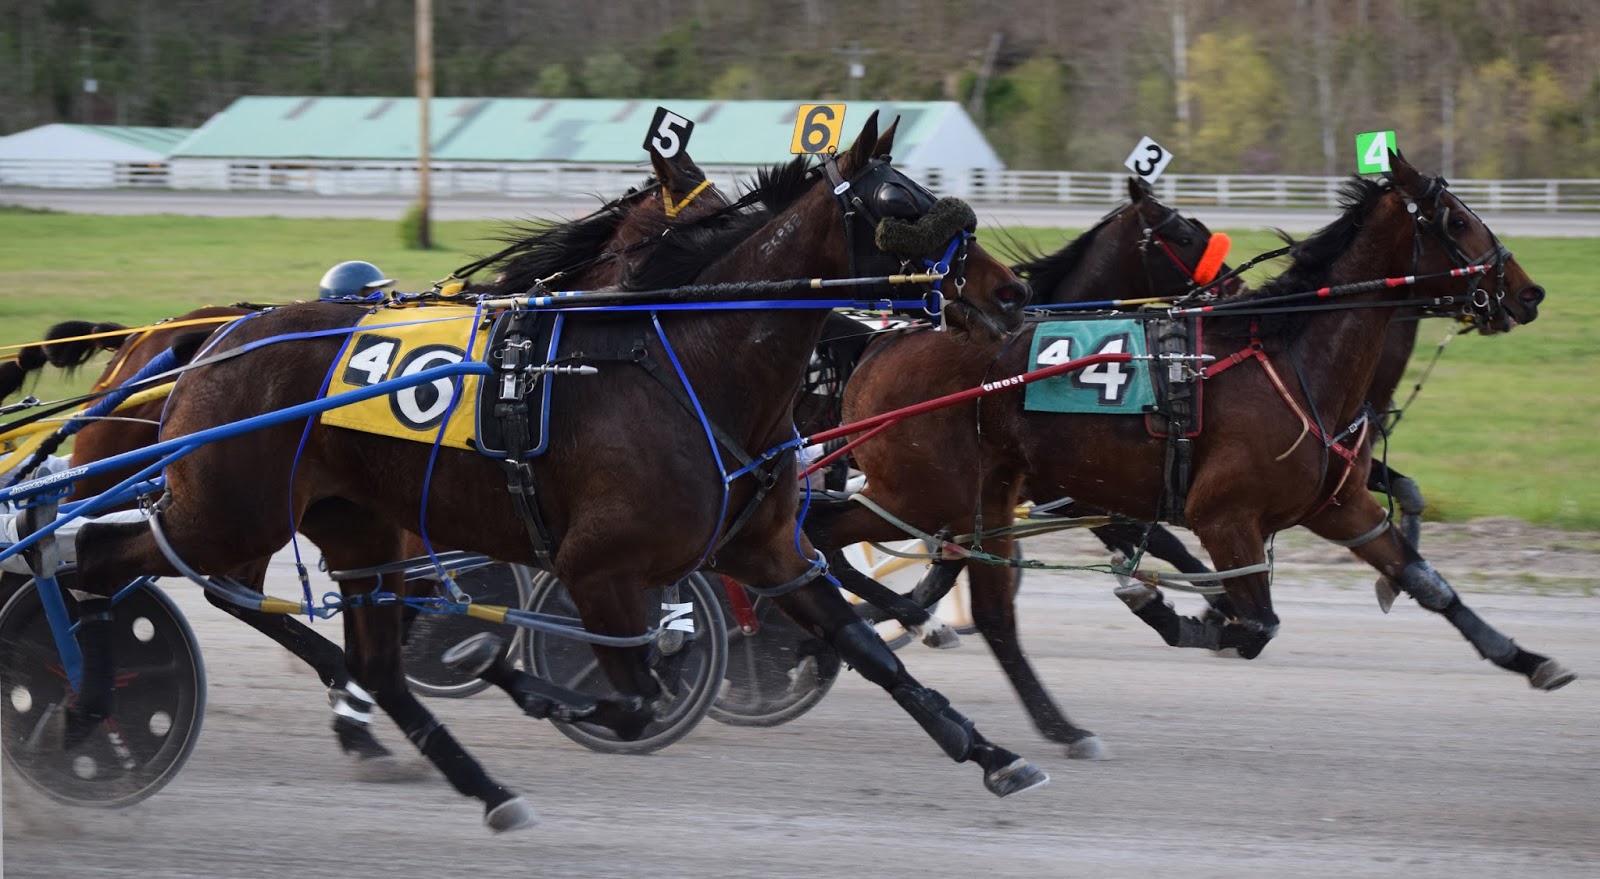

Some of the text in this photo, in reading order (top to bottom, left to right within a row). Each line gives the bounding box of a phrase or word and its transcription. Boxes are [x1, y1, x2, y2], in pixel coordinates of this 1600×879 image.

[652, 112, 688, 158] 5
[800, 106, 835, 152] 6
[1364, 131, 1391, 172] 4
[1135, 144, 1162, 176] 3
[349, 341, 464, 424] 4 6
[1037, 339, 1128, 400] 4 4
[9, 480, 44, 496] James
